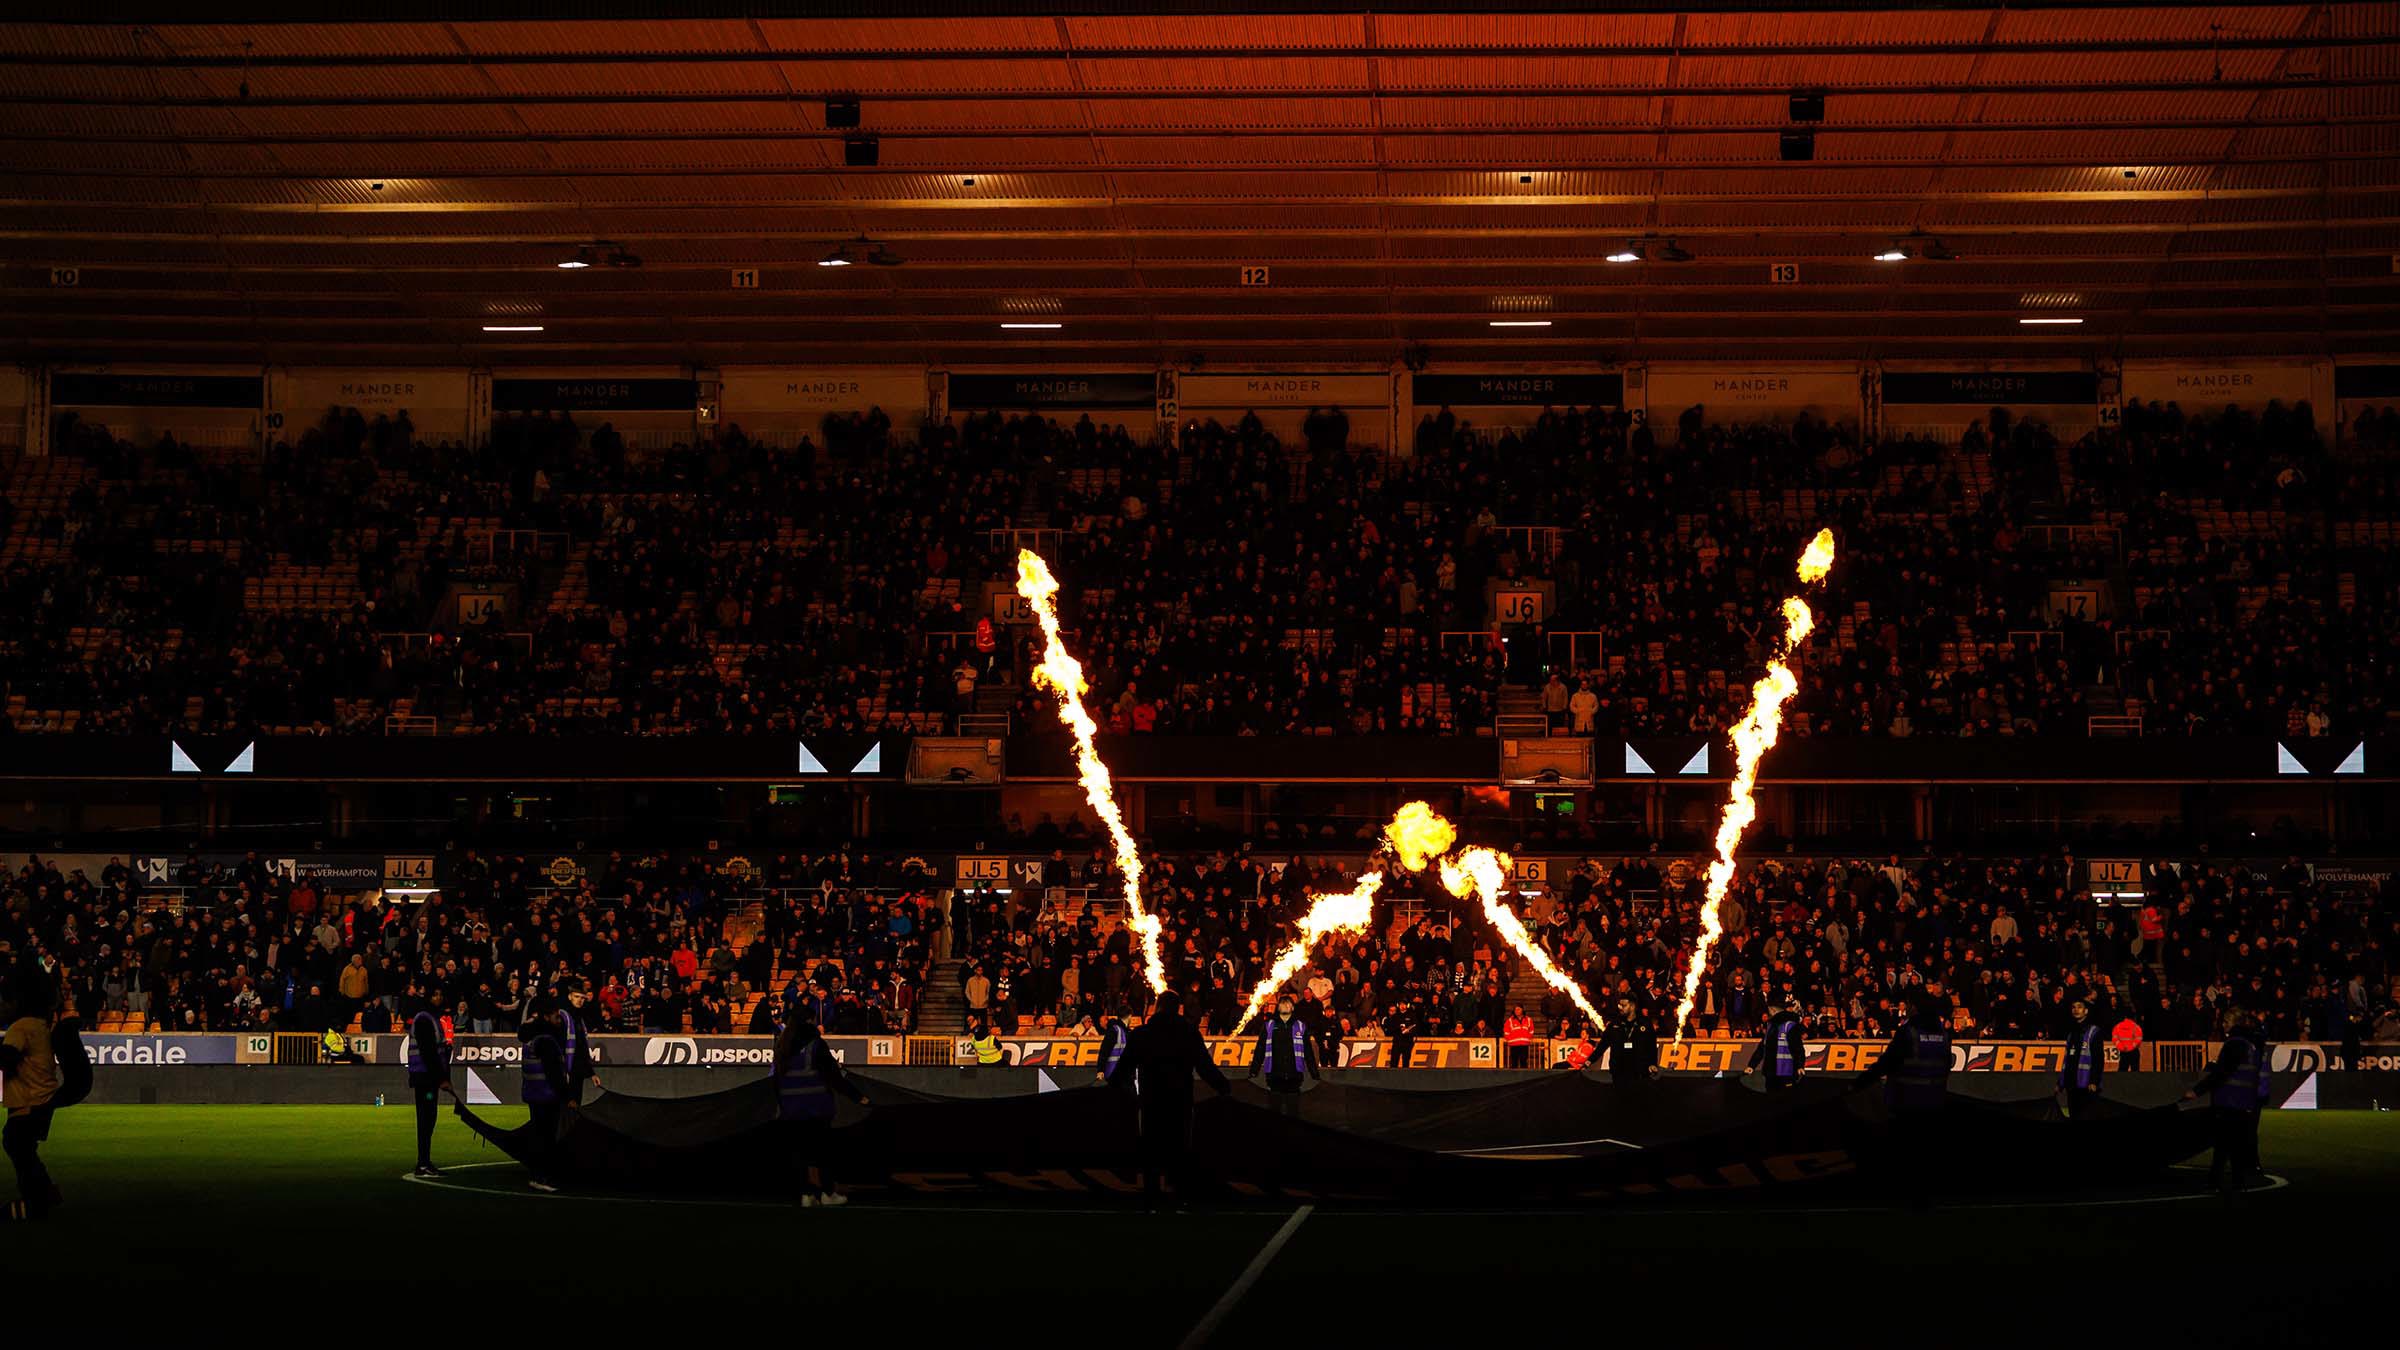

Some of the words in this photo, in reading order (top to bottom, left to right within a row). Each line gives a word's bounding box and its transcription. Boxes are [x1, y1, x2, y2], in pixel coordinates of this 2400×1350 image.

[55, 270, 75, 283] 10
[737, 271, 753, 285] 11
[1244, 269, 1265, 283] 12
[1774, 267, 1795, 280] 13
[1248, 381, 1320, 392] MANDER
[1480, 380, 1553, 392] MANDER
[1714, 379, 1788, 391] MANDER
[1951, 378, 2026, 391] MANDER
[2177, 374, 2254, 387] MANDER
[341, 384, 415, 395] MANDER
[557, 384, 632, 396] MANDER
[787, 383, 859, 394] MANDER
[1016, 382, 1088, 393] MANDER
[1160, 402, 1176, 417] 12
[2101, 408, 2118, 423] 14
[265, 413, 283, 428] 10
[467, 599, 494, 619] J4
[1003, 598, 1030, 619] J5
[1506, 597, 1533, 619] J6
[297, 869, 377, 877] WLVERHAMPTON
[392, 861, 426, 877] JL4
[965, 862, 1000, 878] JL5
[2100, 864, 2132, 880] JL7
[250, 1039, 267, 1051] 10
[355, 1040, 368, 1052] 11
[876, 1042, 889, 1055] 11
[960, 1043, 976, 1055] 12
[83, 1040, 187, 1064] erdale
[1472, 1046, 1489, 1059] 12
[2104, 1048, 2120, 1060] 13
